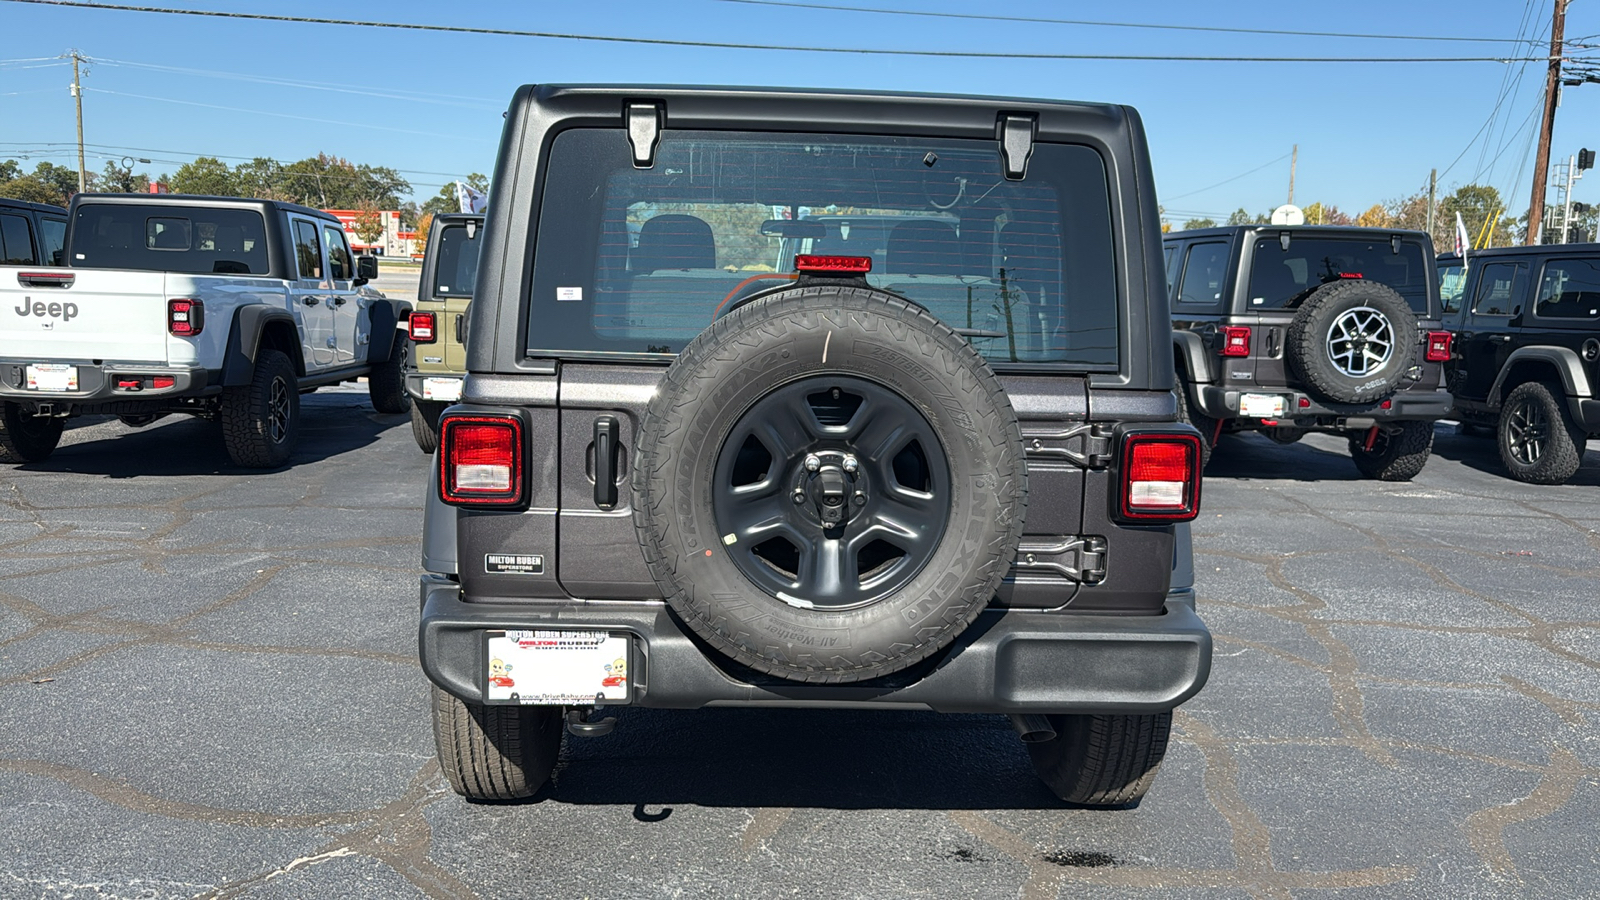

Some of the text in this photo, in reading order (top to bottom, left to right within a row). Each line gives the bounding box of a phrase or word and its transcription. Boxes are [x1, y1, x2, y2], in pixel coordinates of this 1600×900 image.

[15, 296, 78, 321] Jeep
[870, 347, 936, 382] 245/75R17
[677, 406, 714, 535] ROADIAN
[488, 556, 541, 565] MILTON RUBEN
[916, 492, 988, 615] NEXEN
[505, 630, 534, 638] MILTON
[561, 631, 610, 639] SUPERSTORE
